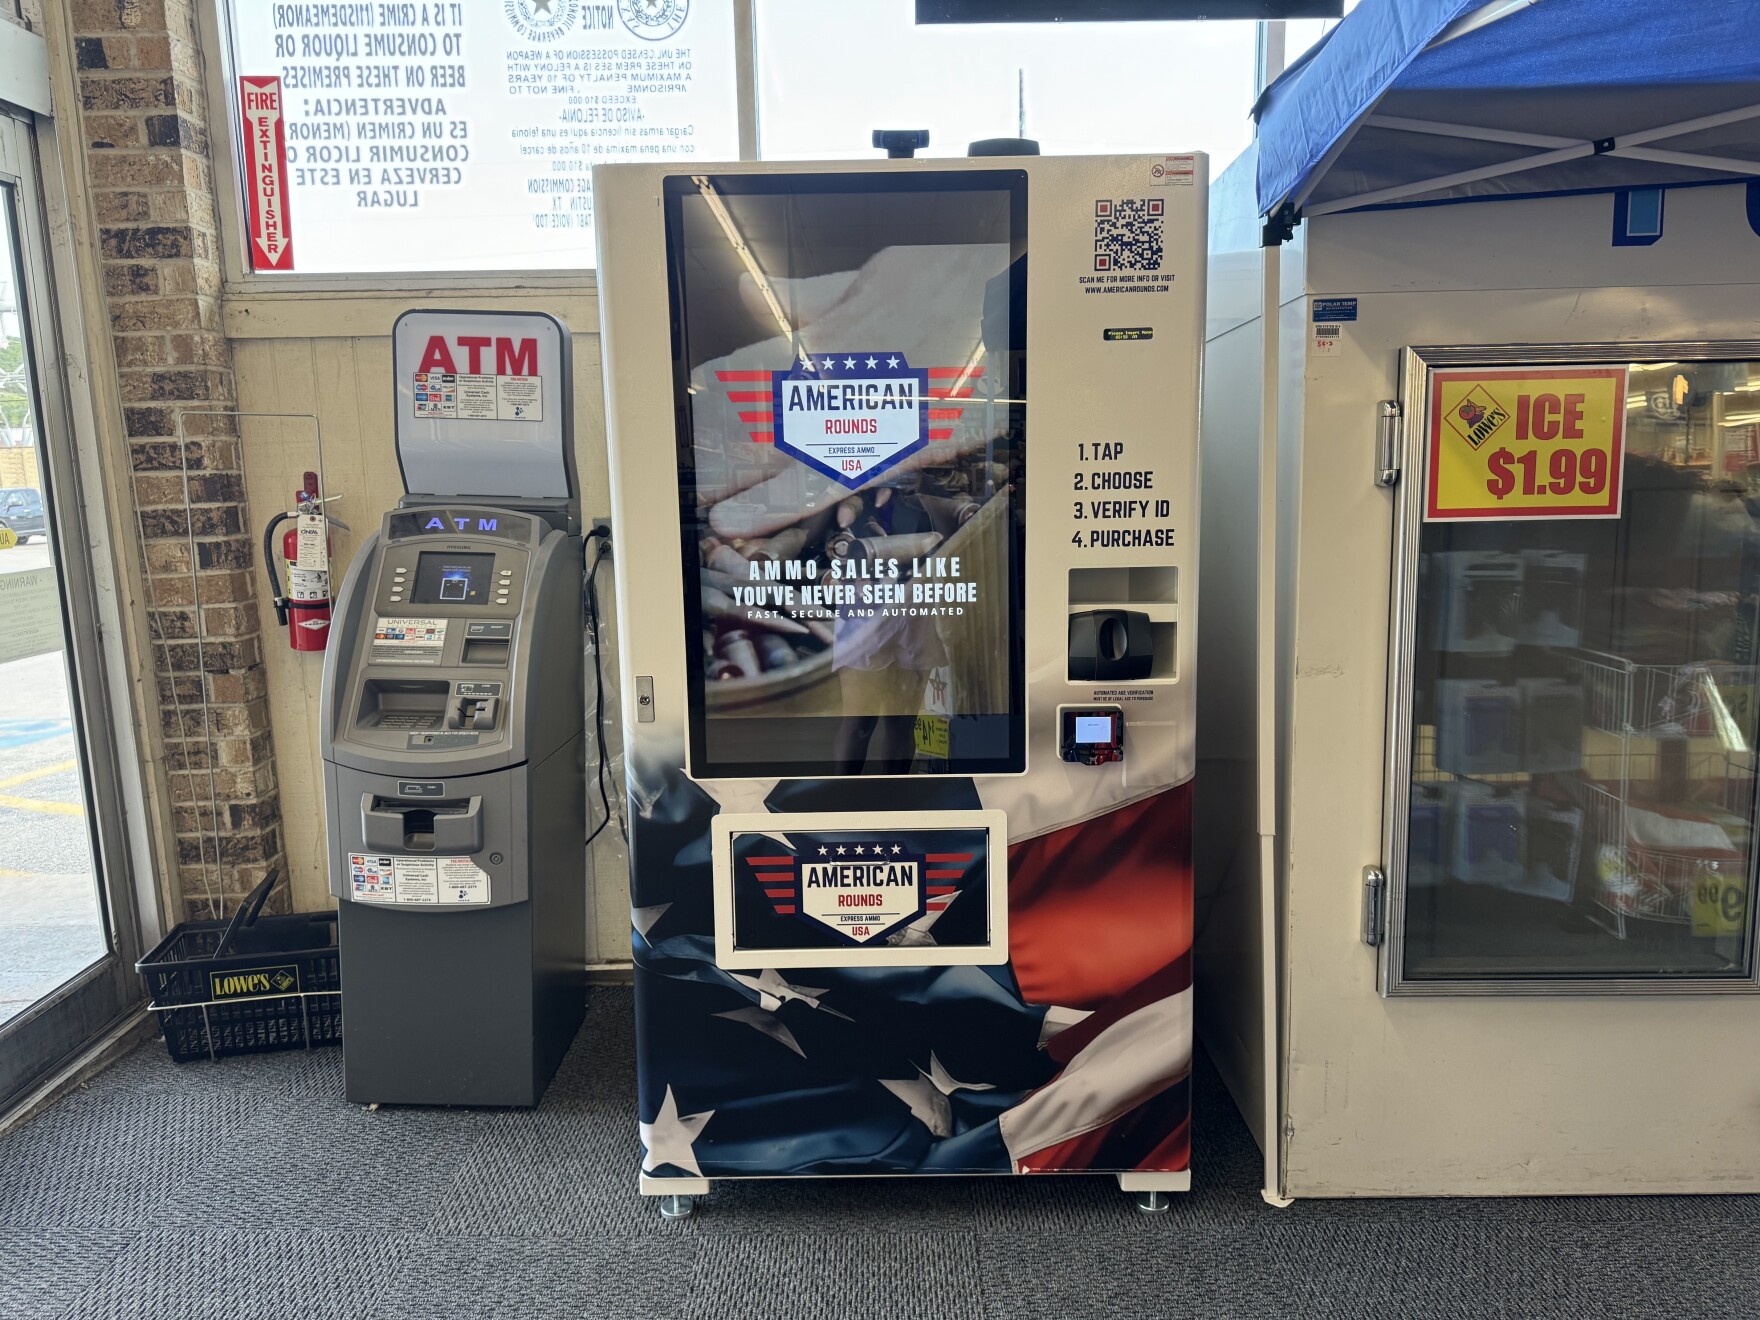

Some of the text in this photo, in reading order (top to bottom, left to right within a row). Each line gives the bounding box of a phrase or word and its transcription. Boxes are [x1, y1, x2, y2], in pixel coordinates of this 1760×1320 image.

[247, 93, 277, 110] FIRE
[258, 116, 279, 253] EXTINGUISHER
[1085, 285, 1169, 294] WWW.AMERICANROUNDS.COM
[418, 335, 538, 376] ATM
[788, 383, 913, 412] AMERICAN
[1515, 393, 1586, 441] ICE
[825, 419, 877, 434] ROUNDS
[857, 446, 875, 454] AMMO
[1092, 442, 1124, 460] TAP
[841, 459, 862, 471] USA
[1486, 447, 1608, 500] $1.99
[1091, 471, 1154, 490] CHOOSE
[1091, 500, 1149, 518] VERIFY
[1155, 500, 1170, 518] ID
[425, 518, 497, 531] ATM
[1090, 528, 1175, 547] PURCHASE
[749, 557, 961, 580] AMMO SALES LIKE
[733, 582, 977, 606] YOU'VE NEVER SEEN BEFORE
[747, 607, 964, 620] FAST, SECURE AND AUTOMATED
[807, 865, 913, 888] AMERICAN
[838, 894, 883, 907] ROUNDS
[852, 926, 870, 936] USA
